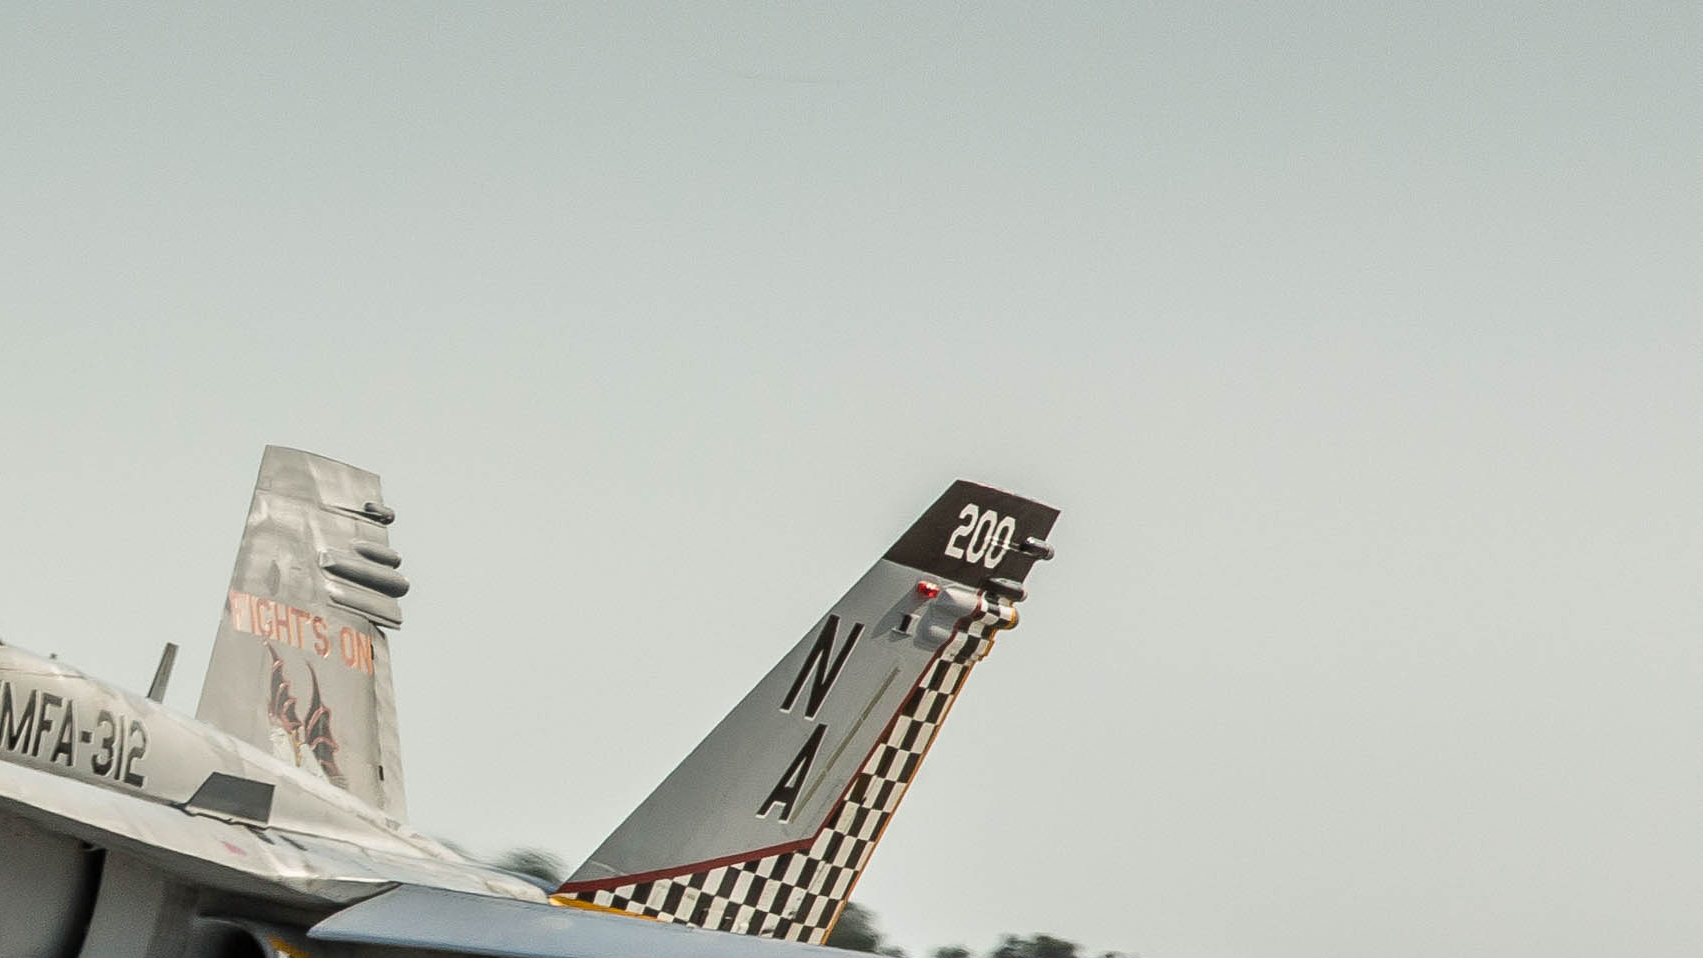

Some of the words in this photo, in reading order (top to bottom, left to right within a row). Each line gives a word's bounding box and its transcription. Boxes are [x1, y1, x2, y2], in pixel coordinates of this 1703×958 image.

[944, 502, 1017, 569] 200
[340, 626, 374, 677] ON
[779, 613, 866, 721] N
[755, 723, 828, 825] A
